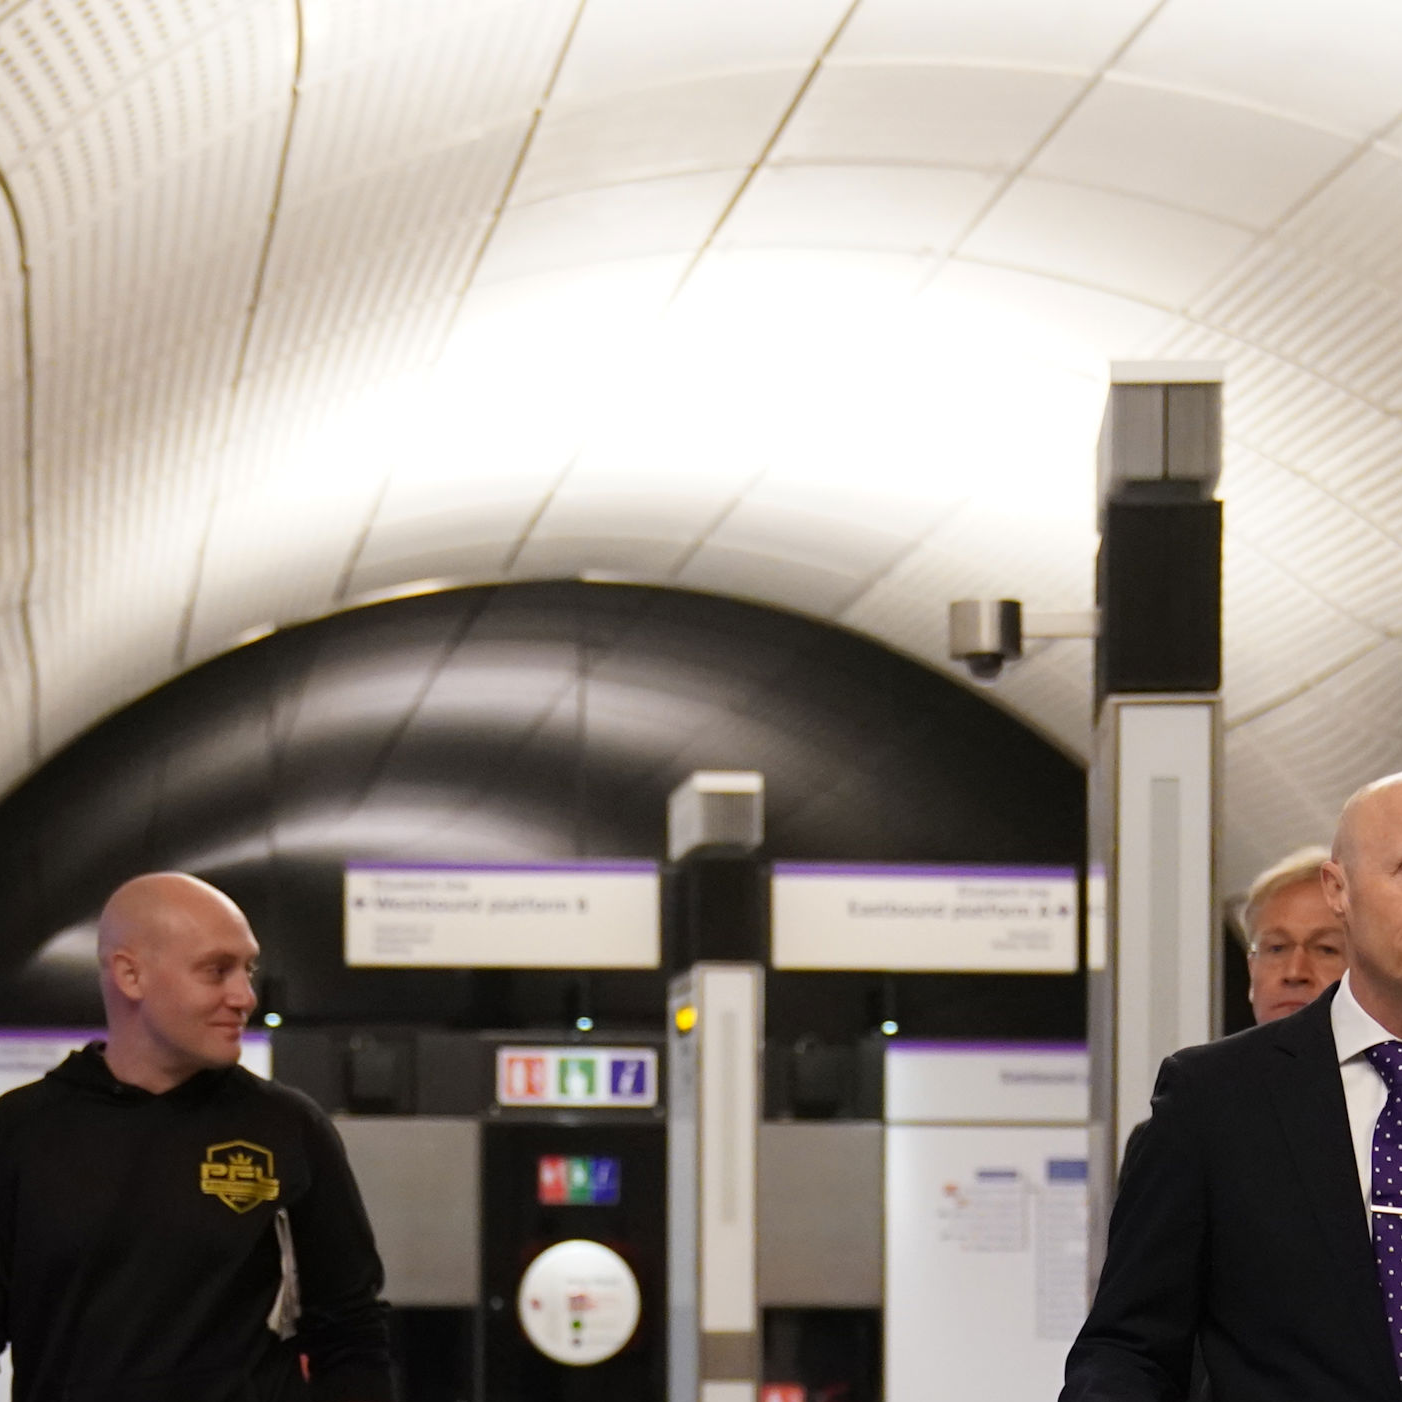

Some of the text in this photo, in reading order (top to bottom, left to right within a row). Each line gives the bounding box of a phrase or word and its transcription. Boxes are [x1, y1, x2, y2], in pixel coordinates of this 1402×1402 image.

[377, 897, 480, 913] Westbound
[488, 897, 568, 916] platform
[952, 902, 1030, 922] platform
